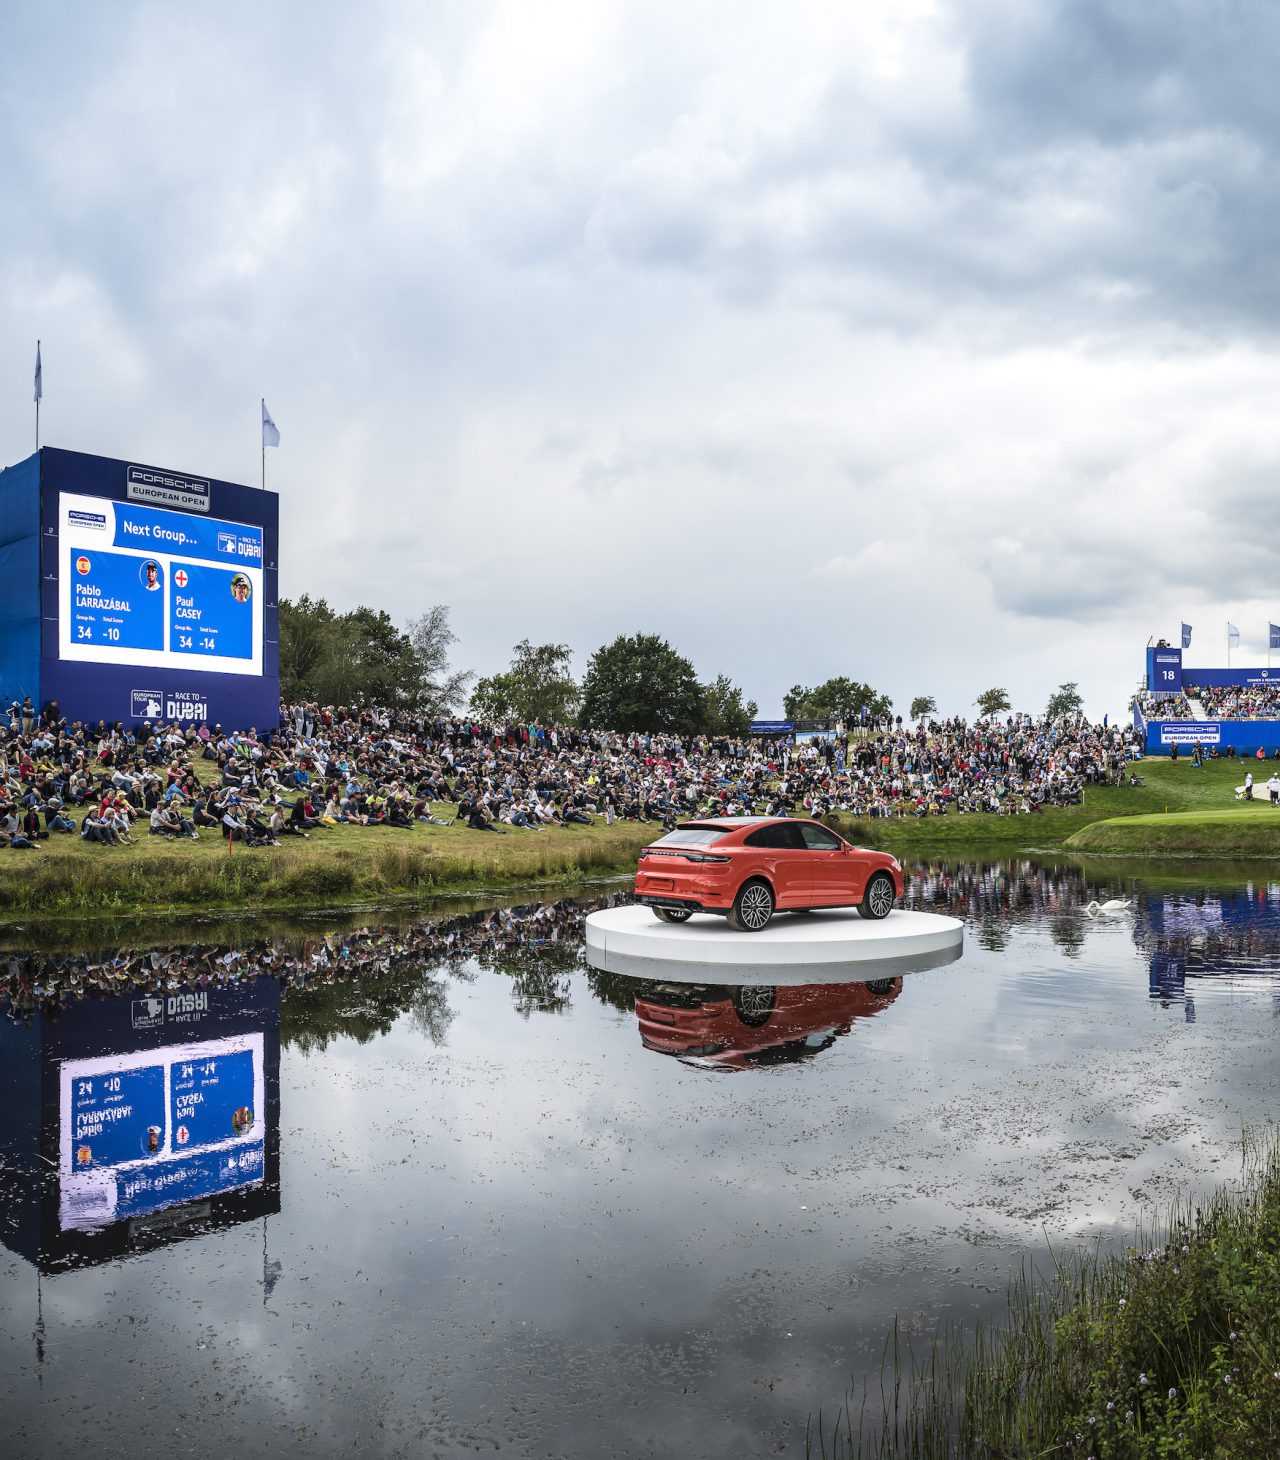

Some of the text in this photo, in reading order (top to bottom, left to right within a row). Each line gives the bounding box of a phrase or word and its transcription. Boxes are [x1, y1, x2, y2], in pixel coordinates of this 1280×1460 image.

[132, 472, 205, 492] PORSCHE
[133, 487, 205, 506] EUROPEAN OPEN
[123, 521, 198, 545] Next Group...
[76, 583, 101, 597] Pablo
[76, 596, 131, 612] LARRAZÁBAL
[176, 595, 194, 607] Paul
[175, 607, 202, 620] CASEY
[77, 625, 93, 639] 34
[102, 628, 120, 641] -10
[179, 635, 193, 649] 34
[199, 637, 215, 650] -14
[1162, 670, 1176, 680] 18
[175, 692, 200, 701] RACE TO
[167, 700, 208, 721] DUBAI
